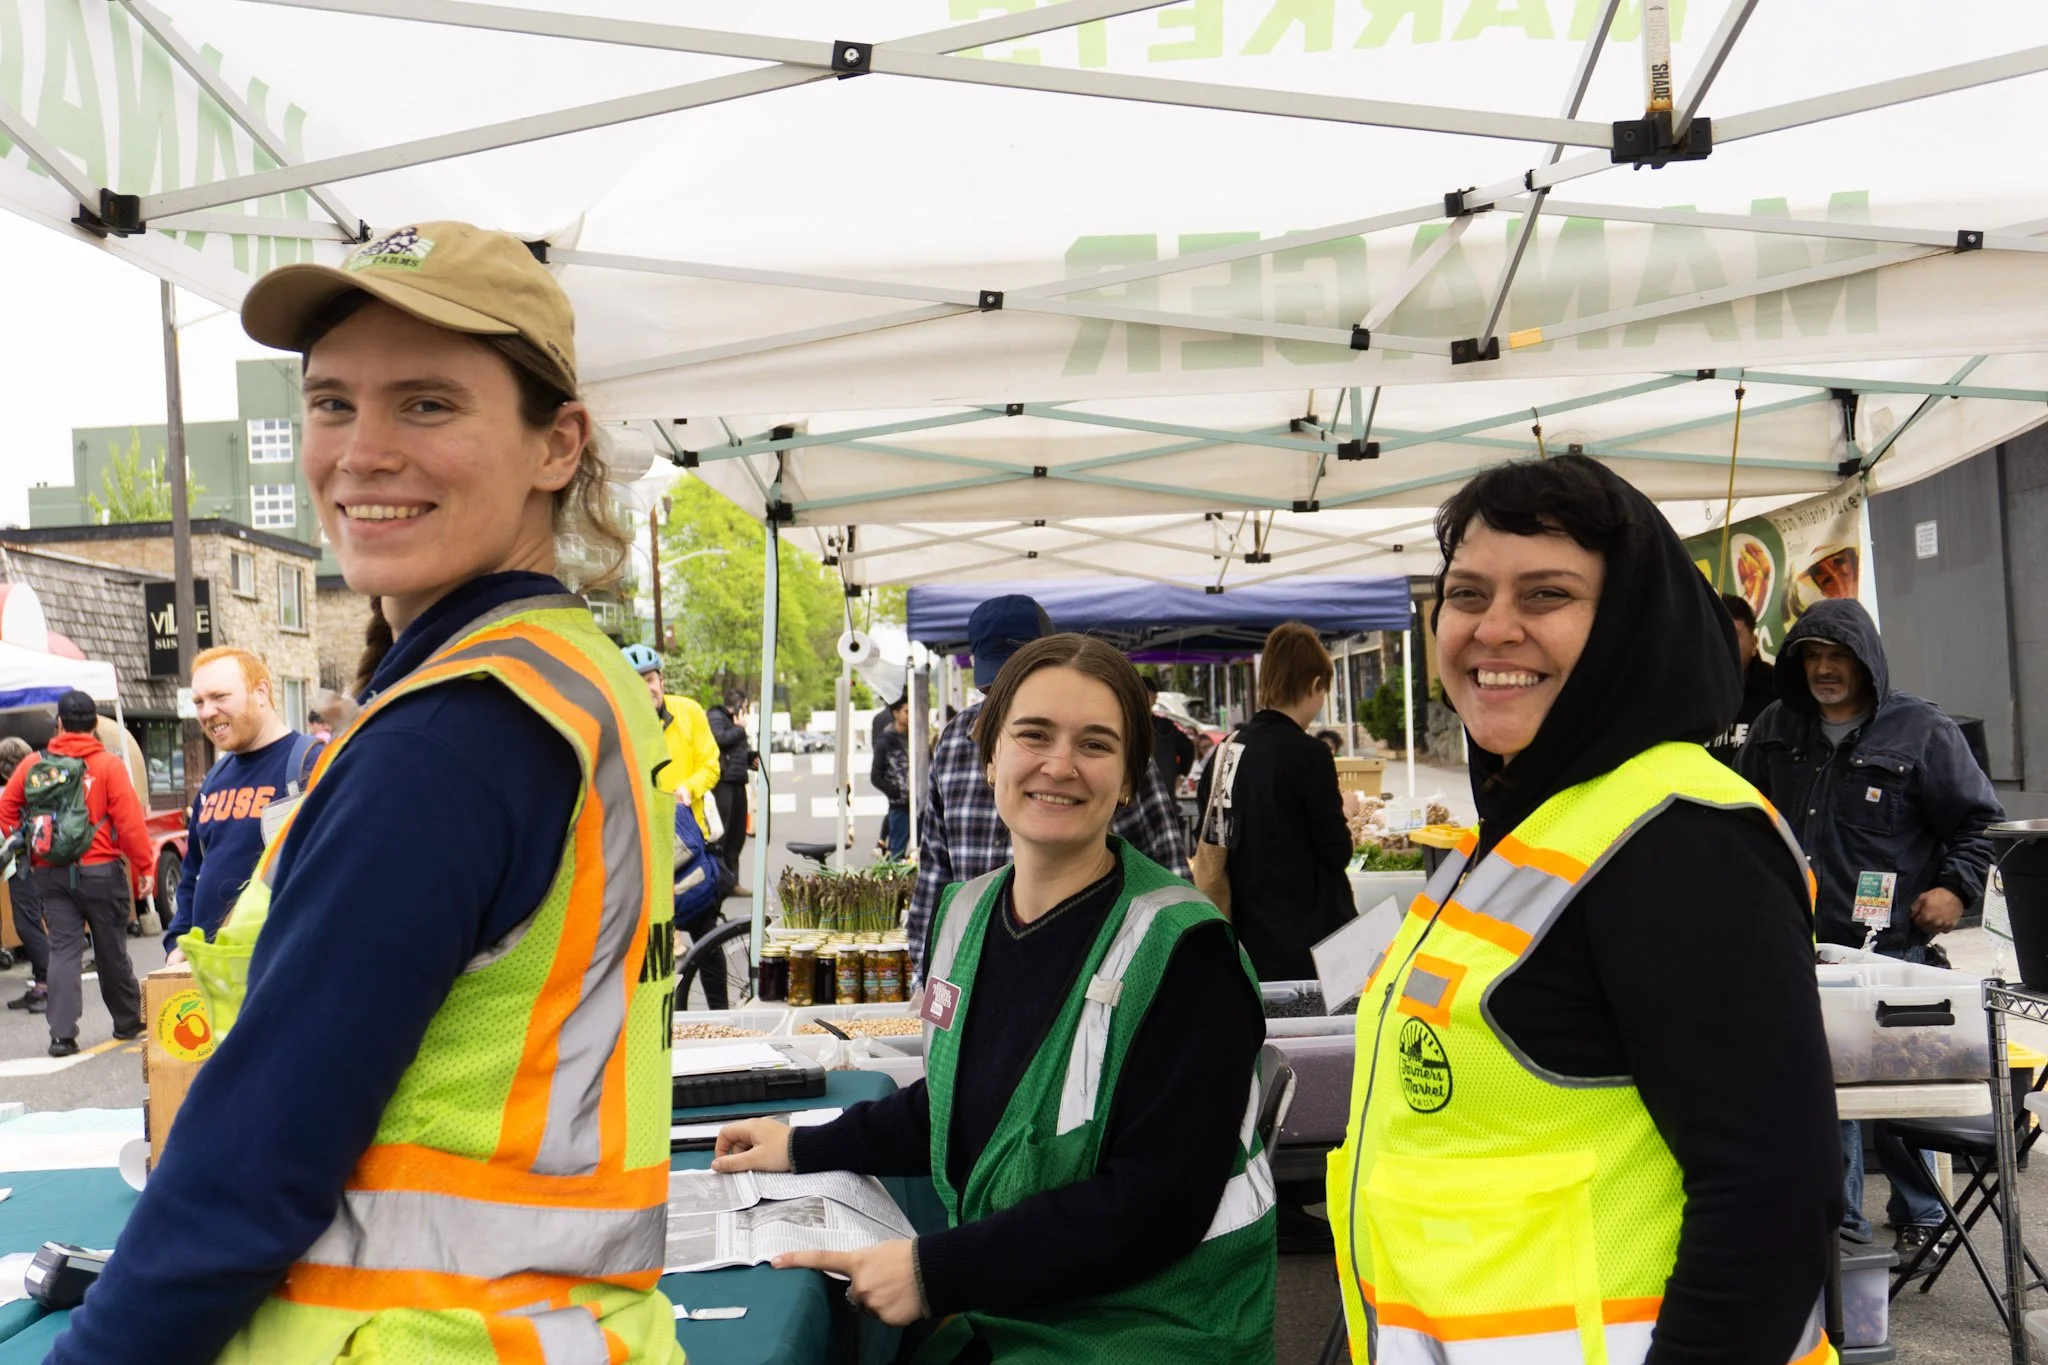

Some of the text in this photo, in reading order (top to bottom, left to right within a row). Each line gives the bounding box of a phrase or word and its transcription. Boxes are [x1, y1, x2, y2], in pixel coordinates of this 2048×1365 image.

[371, 256, 421, 268] FARMS
[198, 786, 277, 824] CUSE
[1402, 1059, 1444, 1082] Farmers
[1404, 1077, 1445, 1098] Market
